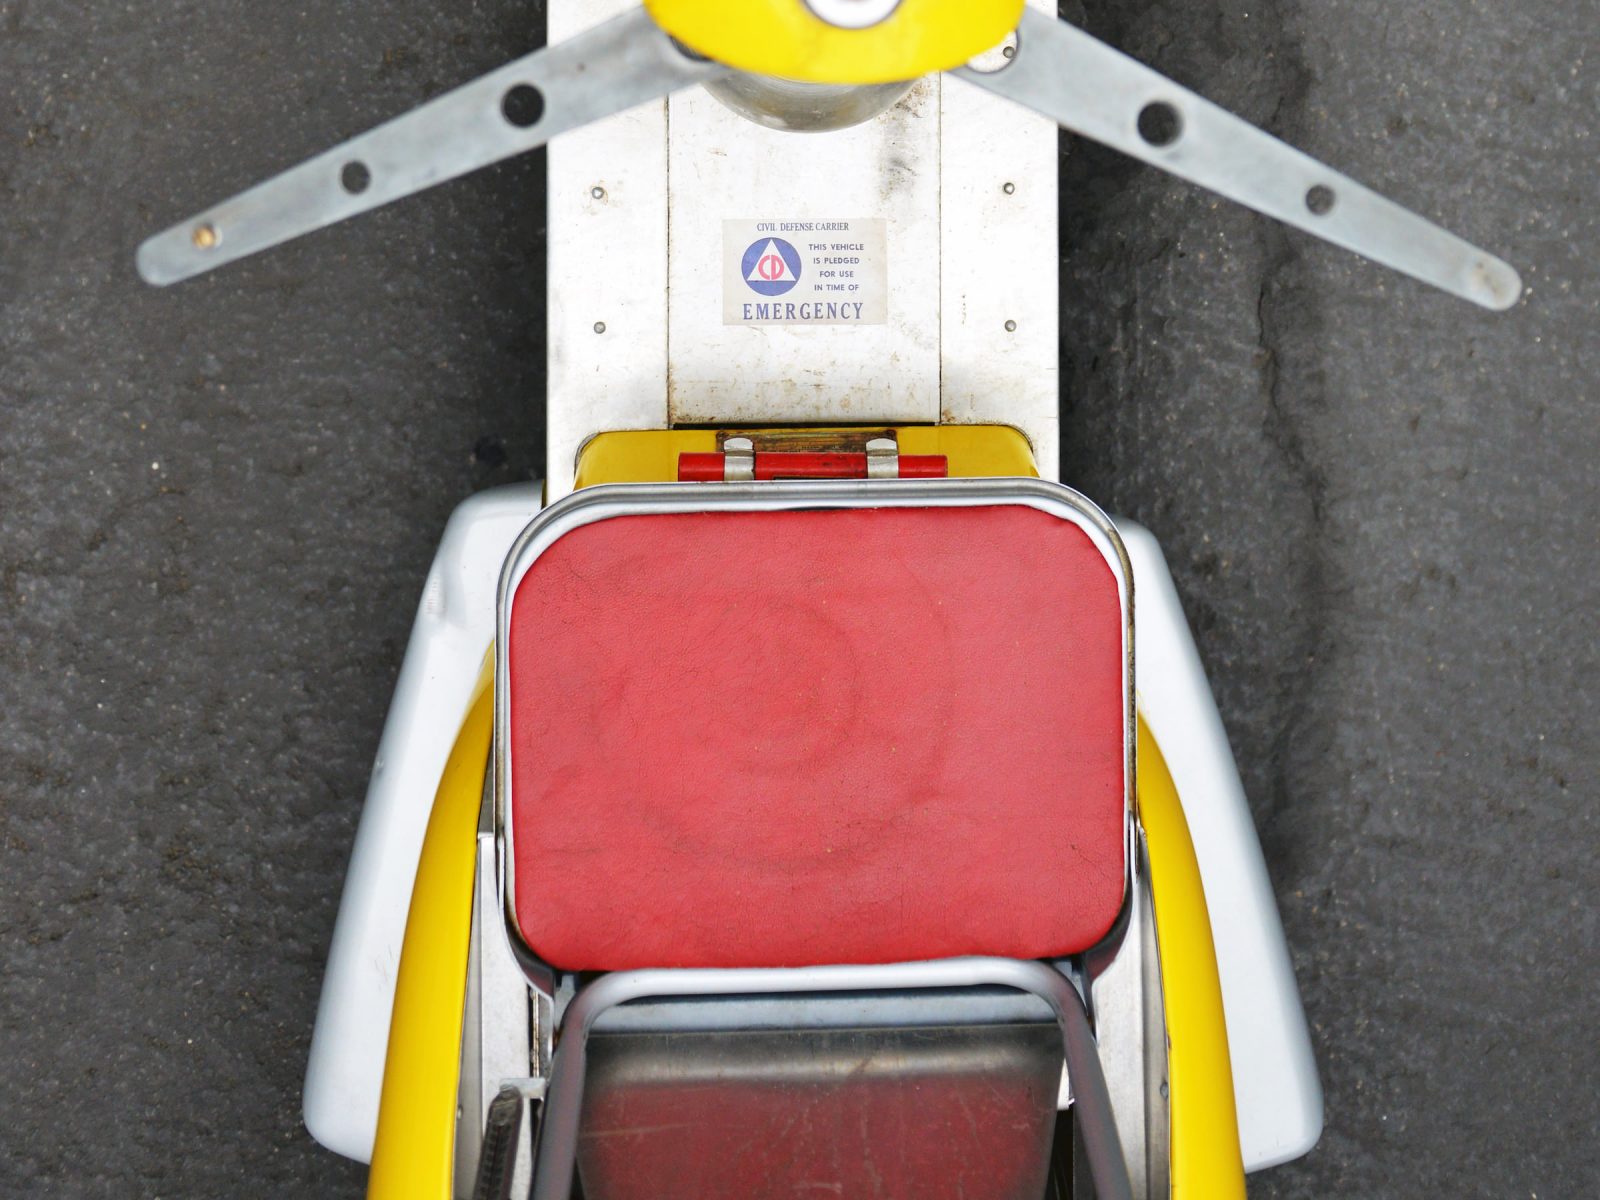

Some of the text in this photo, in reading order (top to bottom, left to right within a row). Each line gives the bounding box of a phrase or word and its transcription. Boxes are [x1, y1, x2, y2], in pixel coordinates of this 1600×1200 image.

[756, 222, 849, 232] CIVIL DEFENSE CARRIER
[808, 243, 864, 251] THIS VEHICLE
[757, 254, 785, 281] CD
[743, 302, 864, 320] EMERGENCY
